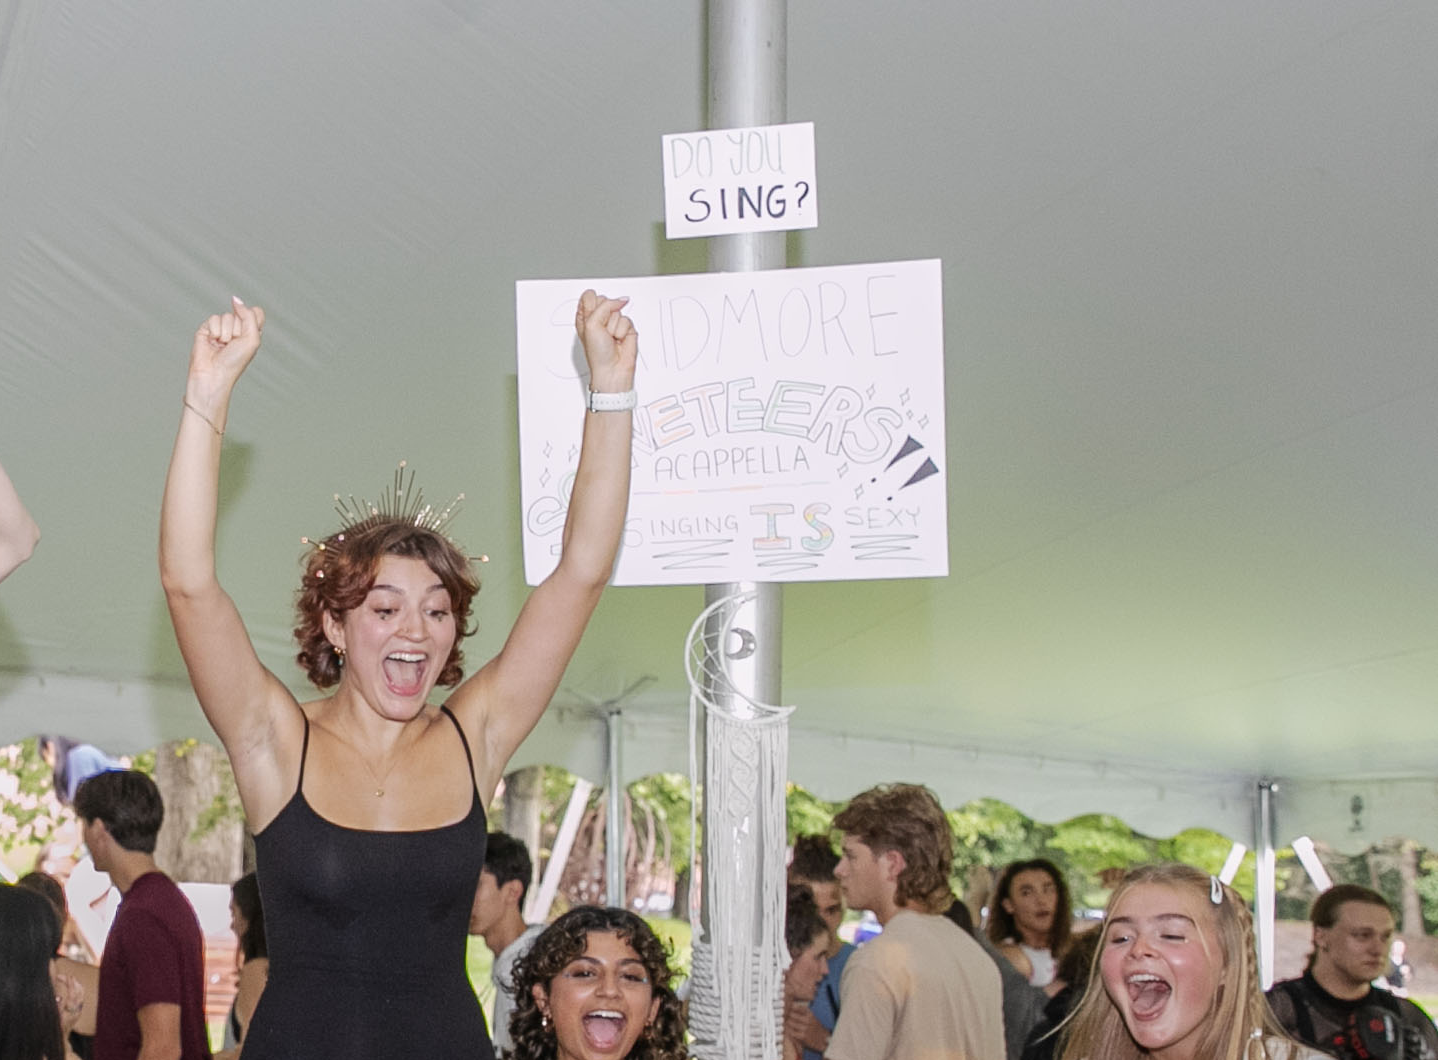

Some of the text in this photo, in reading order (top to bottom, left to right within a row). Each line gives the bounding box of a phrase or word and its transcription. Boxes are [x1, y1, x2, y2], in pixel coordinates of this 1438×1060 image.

[669, 130, 786, 179] DO YOU
[684, 180, 810, 223] SING?
[654, 445, 810, 483] ACAPPELLA
[749, 502, 835, 552] IS
[843, 506, 921, 530] SEXY
